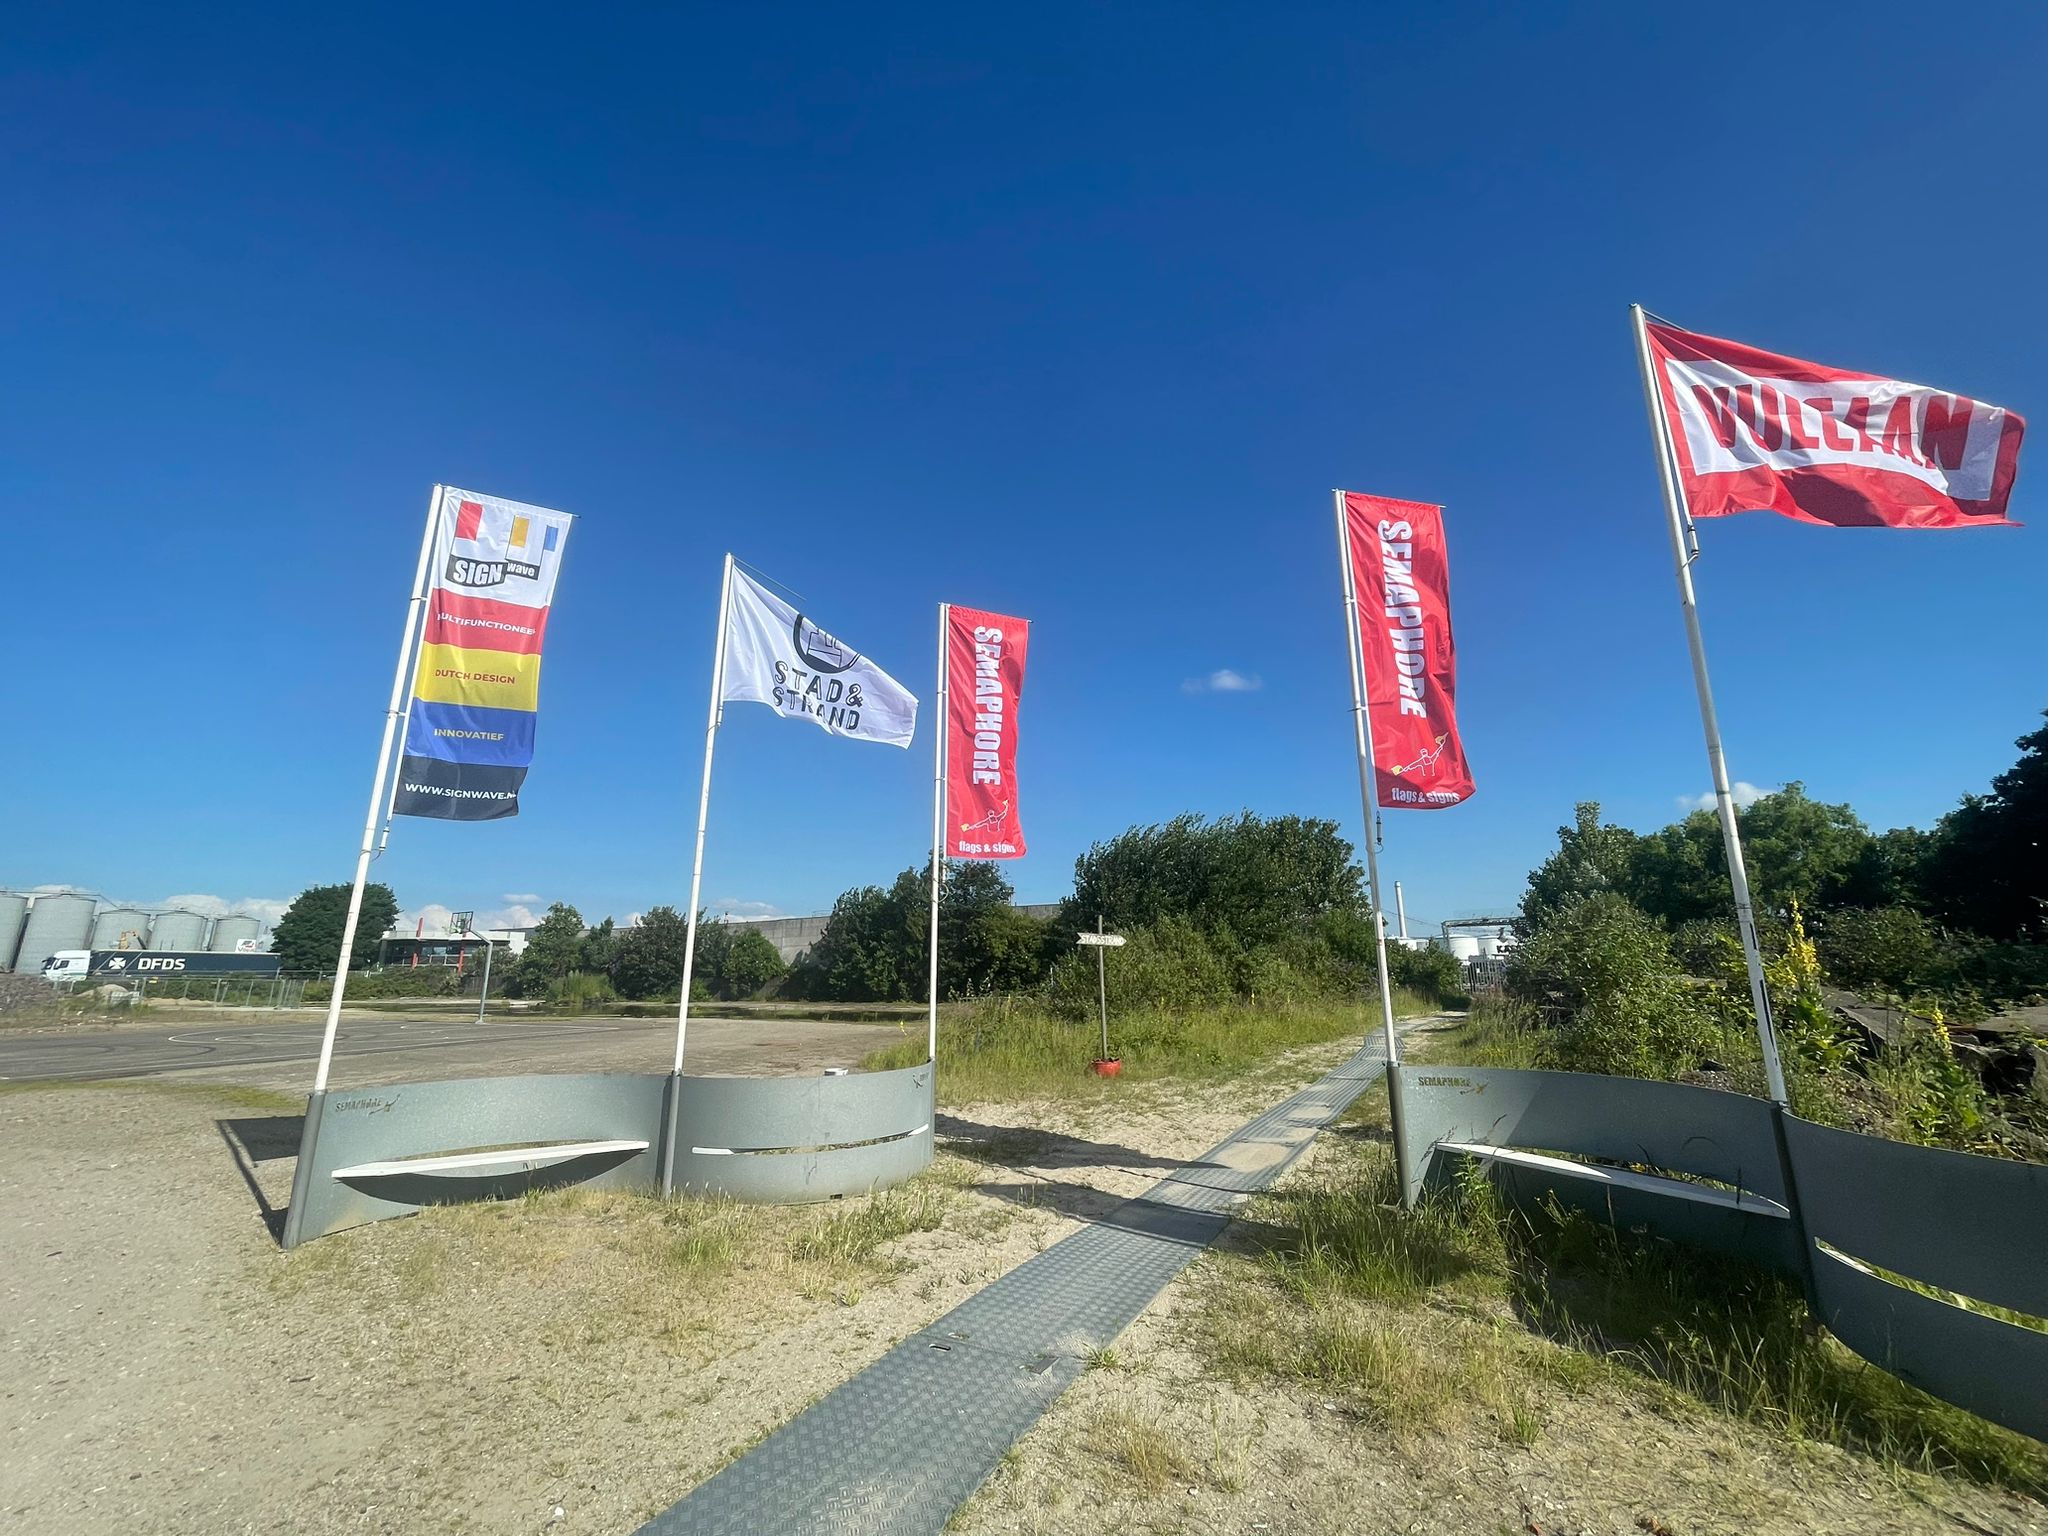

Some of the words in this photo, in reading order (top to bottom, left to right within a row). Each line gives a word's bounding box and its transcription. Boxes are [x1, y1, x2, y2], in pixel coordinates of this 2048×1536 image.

[452, 560, 504, 586] SIGN
[507, 562, 536, 577] wave
[1377, 519, 1427, 719] SEMAPHORE
[435, 669, 471, 680] DUTCH
[473, 673, 515, 684] DESIGN
[772, 686, 860, 730] STRAND
[972, 625, 1003, 786] SEMAPHORE
[434, 728, 504, 741] INNOVATIEF
[1391, 787, 1417, 803] flags
[1417, 791, 1426, 803] &
[1426, 790, 1460, 804] signs
[959, 840, 982, 854] flags
[983, 843, 991, 853] &
[137, 957, 186, 970] DFDS
